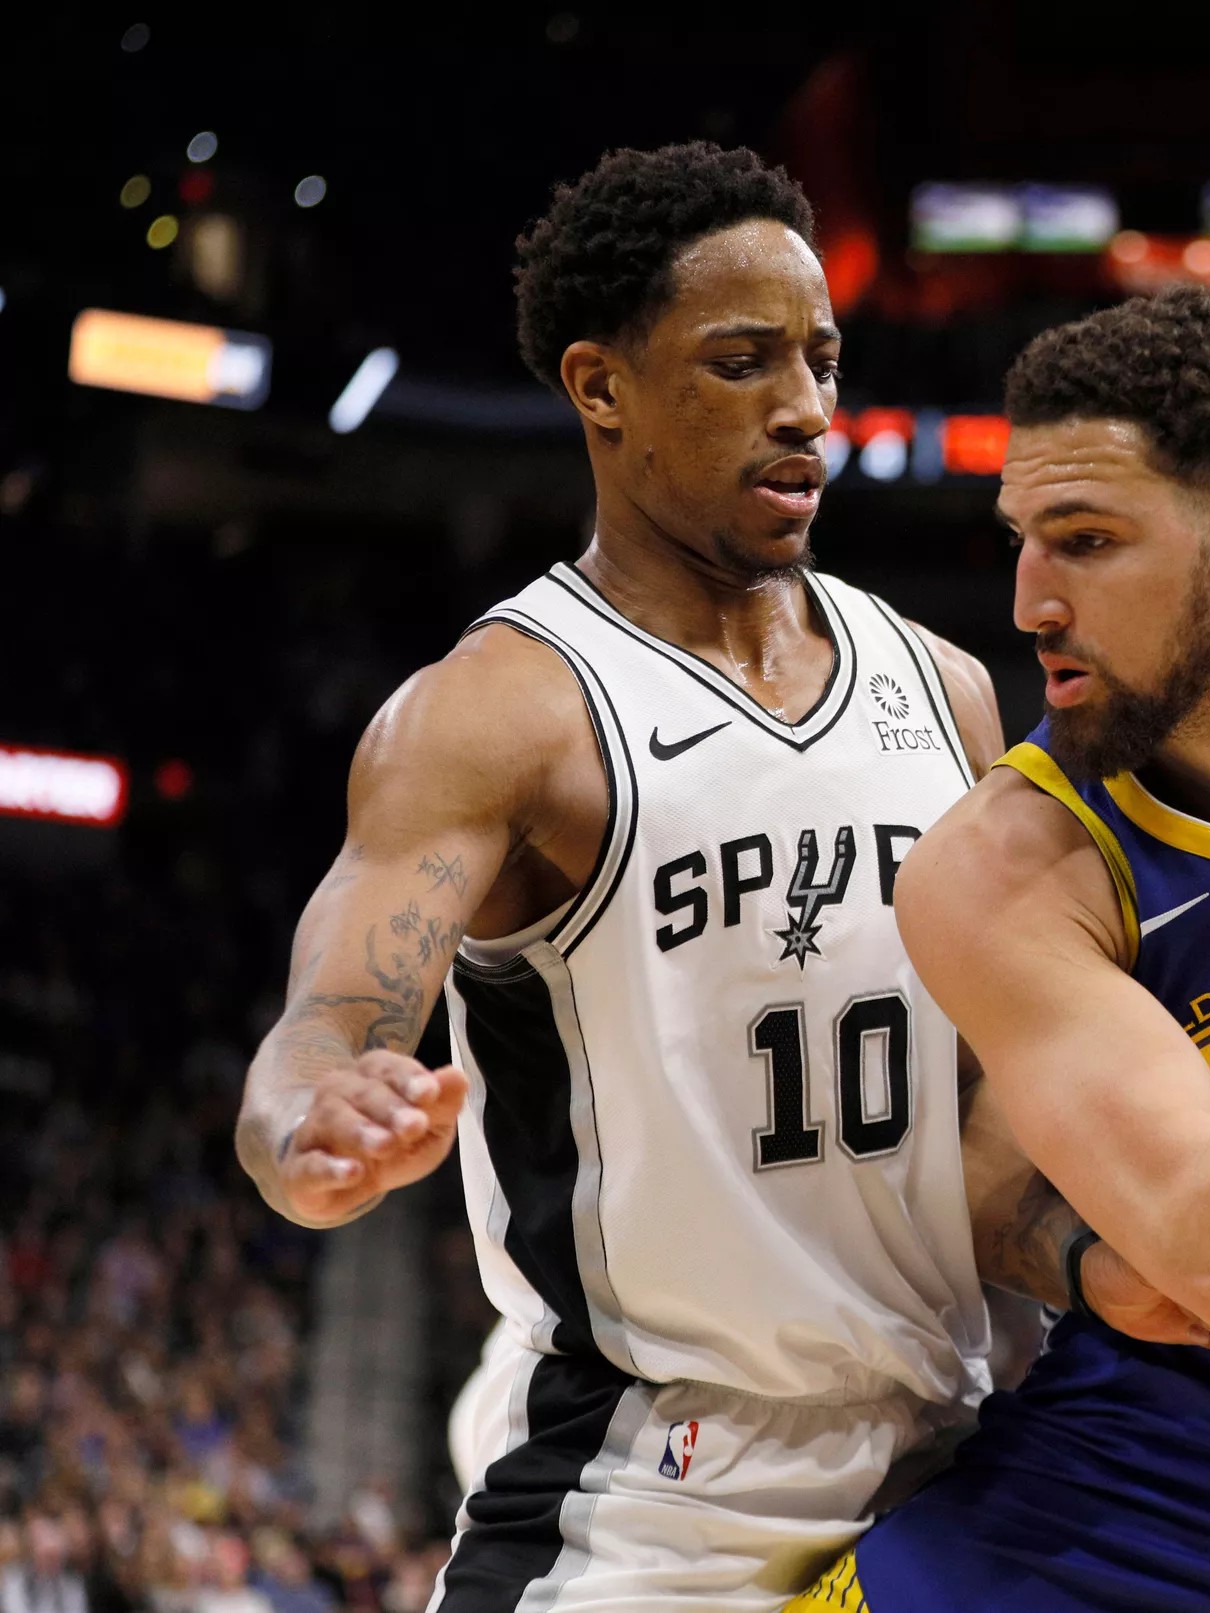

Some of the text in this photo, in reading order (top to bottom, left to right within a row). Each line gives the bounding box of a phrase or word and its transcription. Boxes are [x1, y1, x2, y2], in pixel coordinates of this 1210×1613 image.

[871, 720, 942, 752] Frost
[746, 988, 913, 1173] 10
[661, 1463, 677, 1478] NBA
